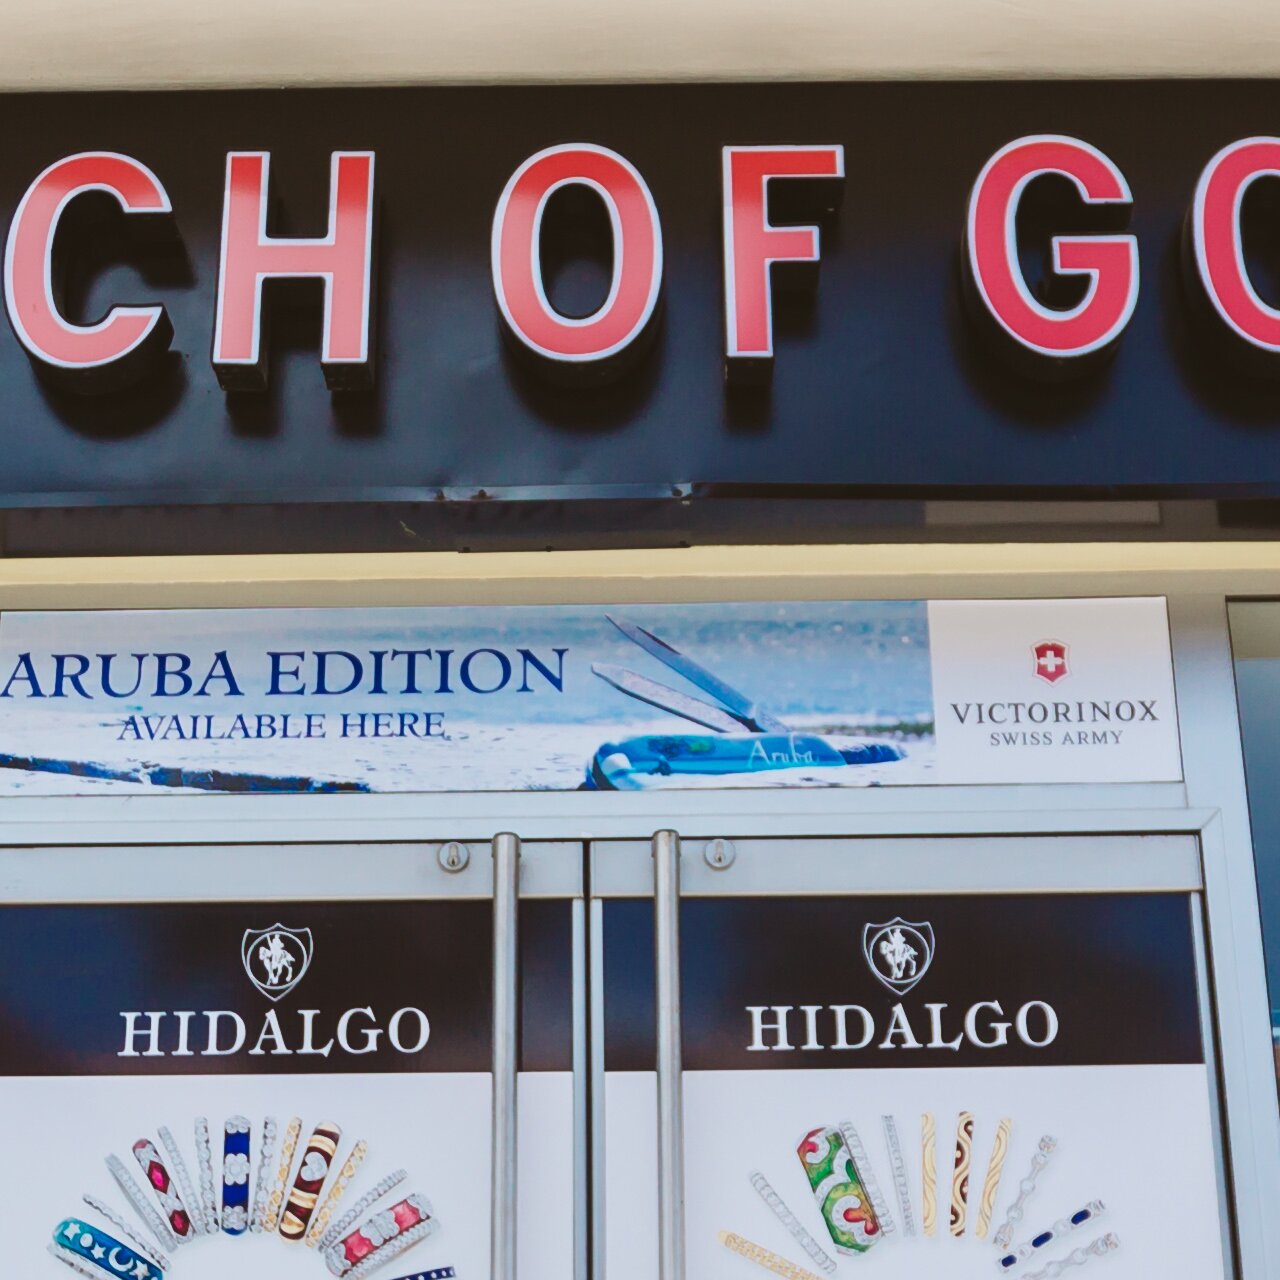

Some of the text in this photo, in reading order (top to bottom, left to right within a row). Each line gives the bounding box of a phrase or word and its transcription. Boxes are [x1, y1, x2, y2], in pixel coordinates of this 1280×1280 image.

[492, 143, 844, 362] OF
[265, 647, 570, 696] EDITION
[116, 711, 447, 741] AVAILABLE HERE
[950, 699, 1160, 725] VICTORINOX
[747, 732, 817, 768] Aruba
[990, 729, 1124, 747] SWISS ARMY
[117, 1006, 431, 1058] HIDALGO
[745, 1000, 1058, 1051] HIDALGO
